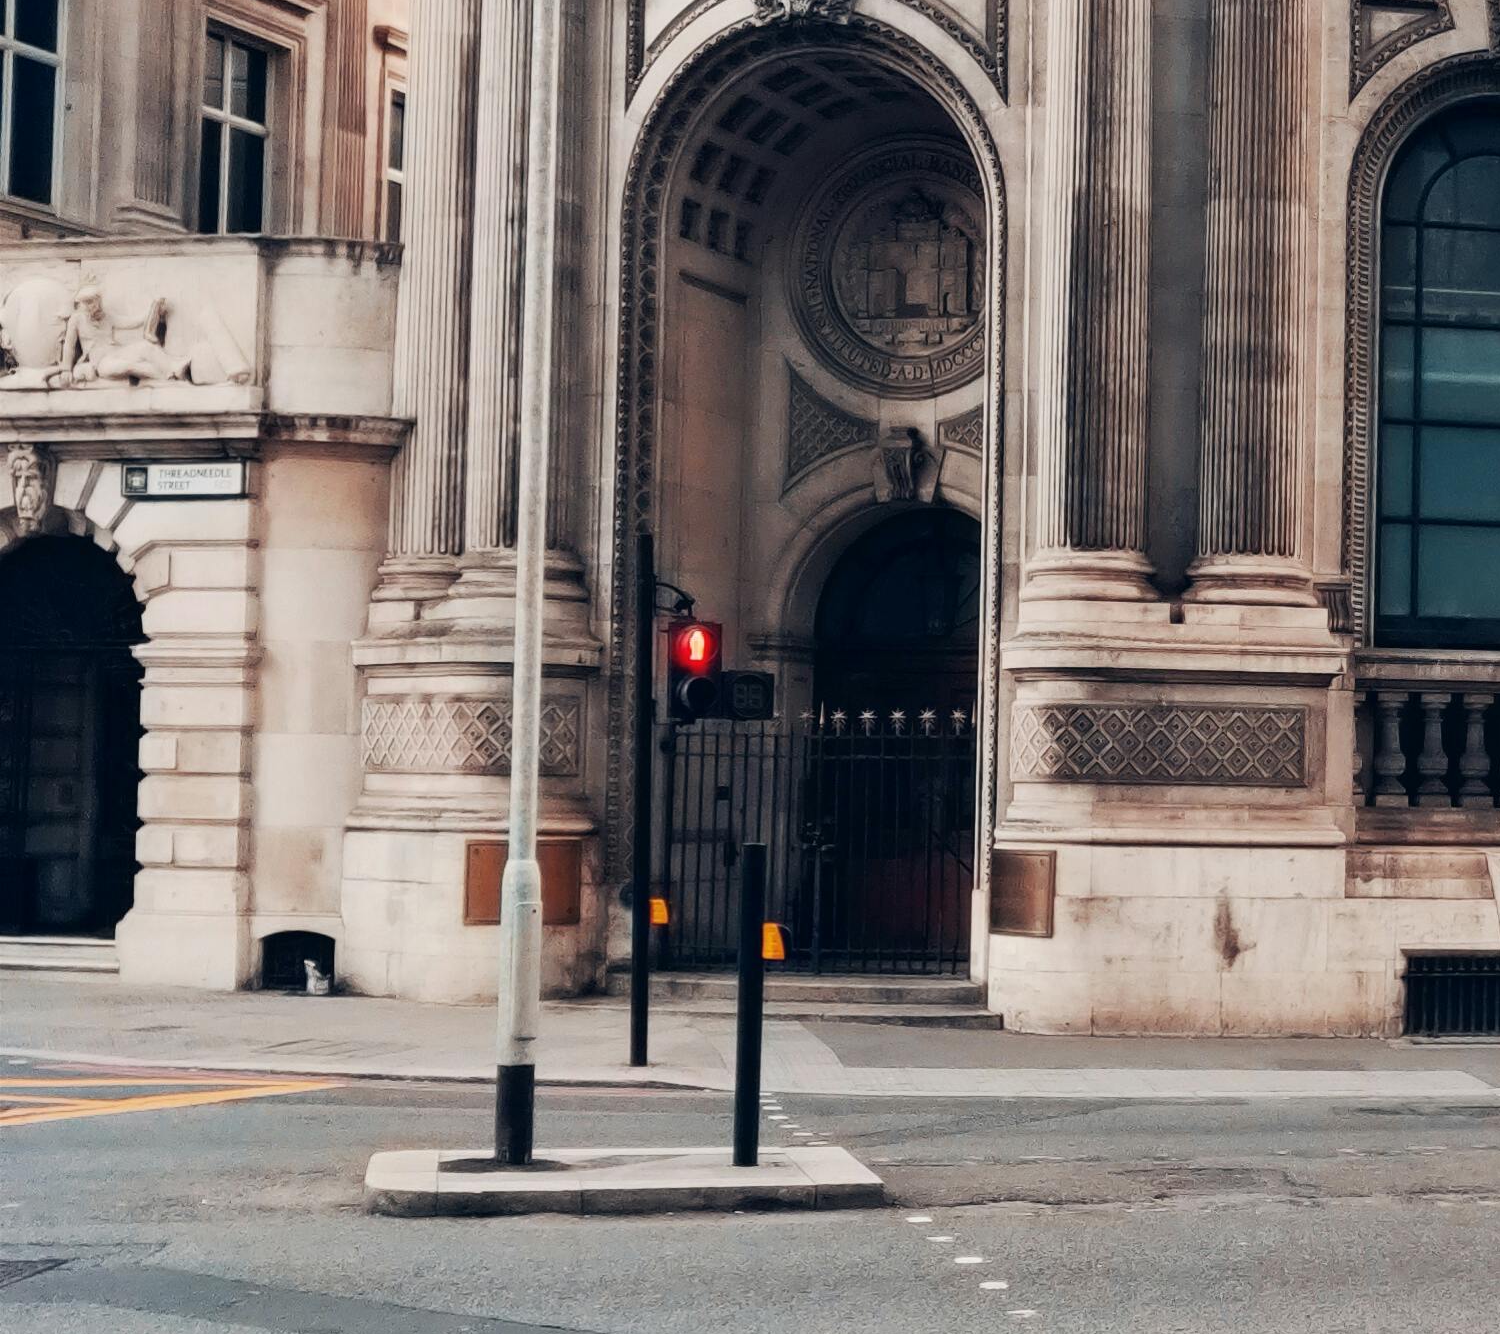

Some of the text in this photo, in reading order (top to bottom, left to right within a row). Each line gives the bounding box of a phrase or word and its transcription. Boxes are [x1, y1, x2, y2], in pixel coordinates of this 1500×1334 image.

[804, 208, 832, 292] NATIONAL
[932, 332, 984, 379] MDCCC
[158, 480, 190, 490] STREET
[159, 468, 232, 478] THREADNEEDLE
